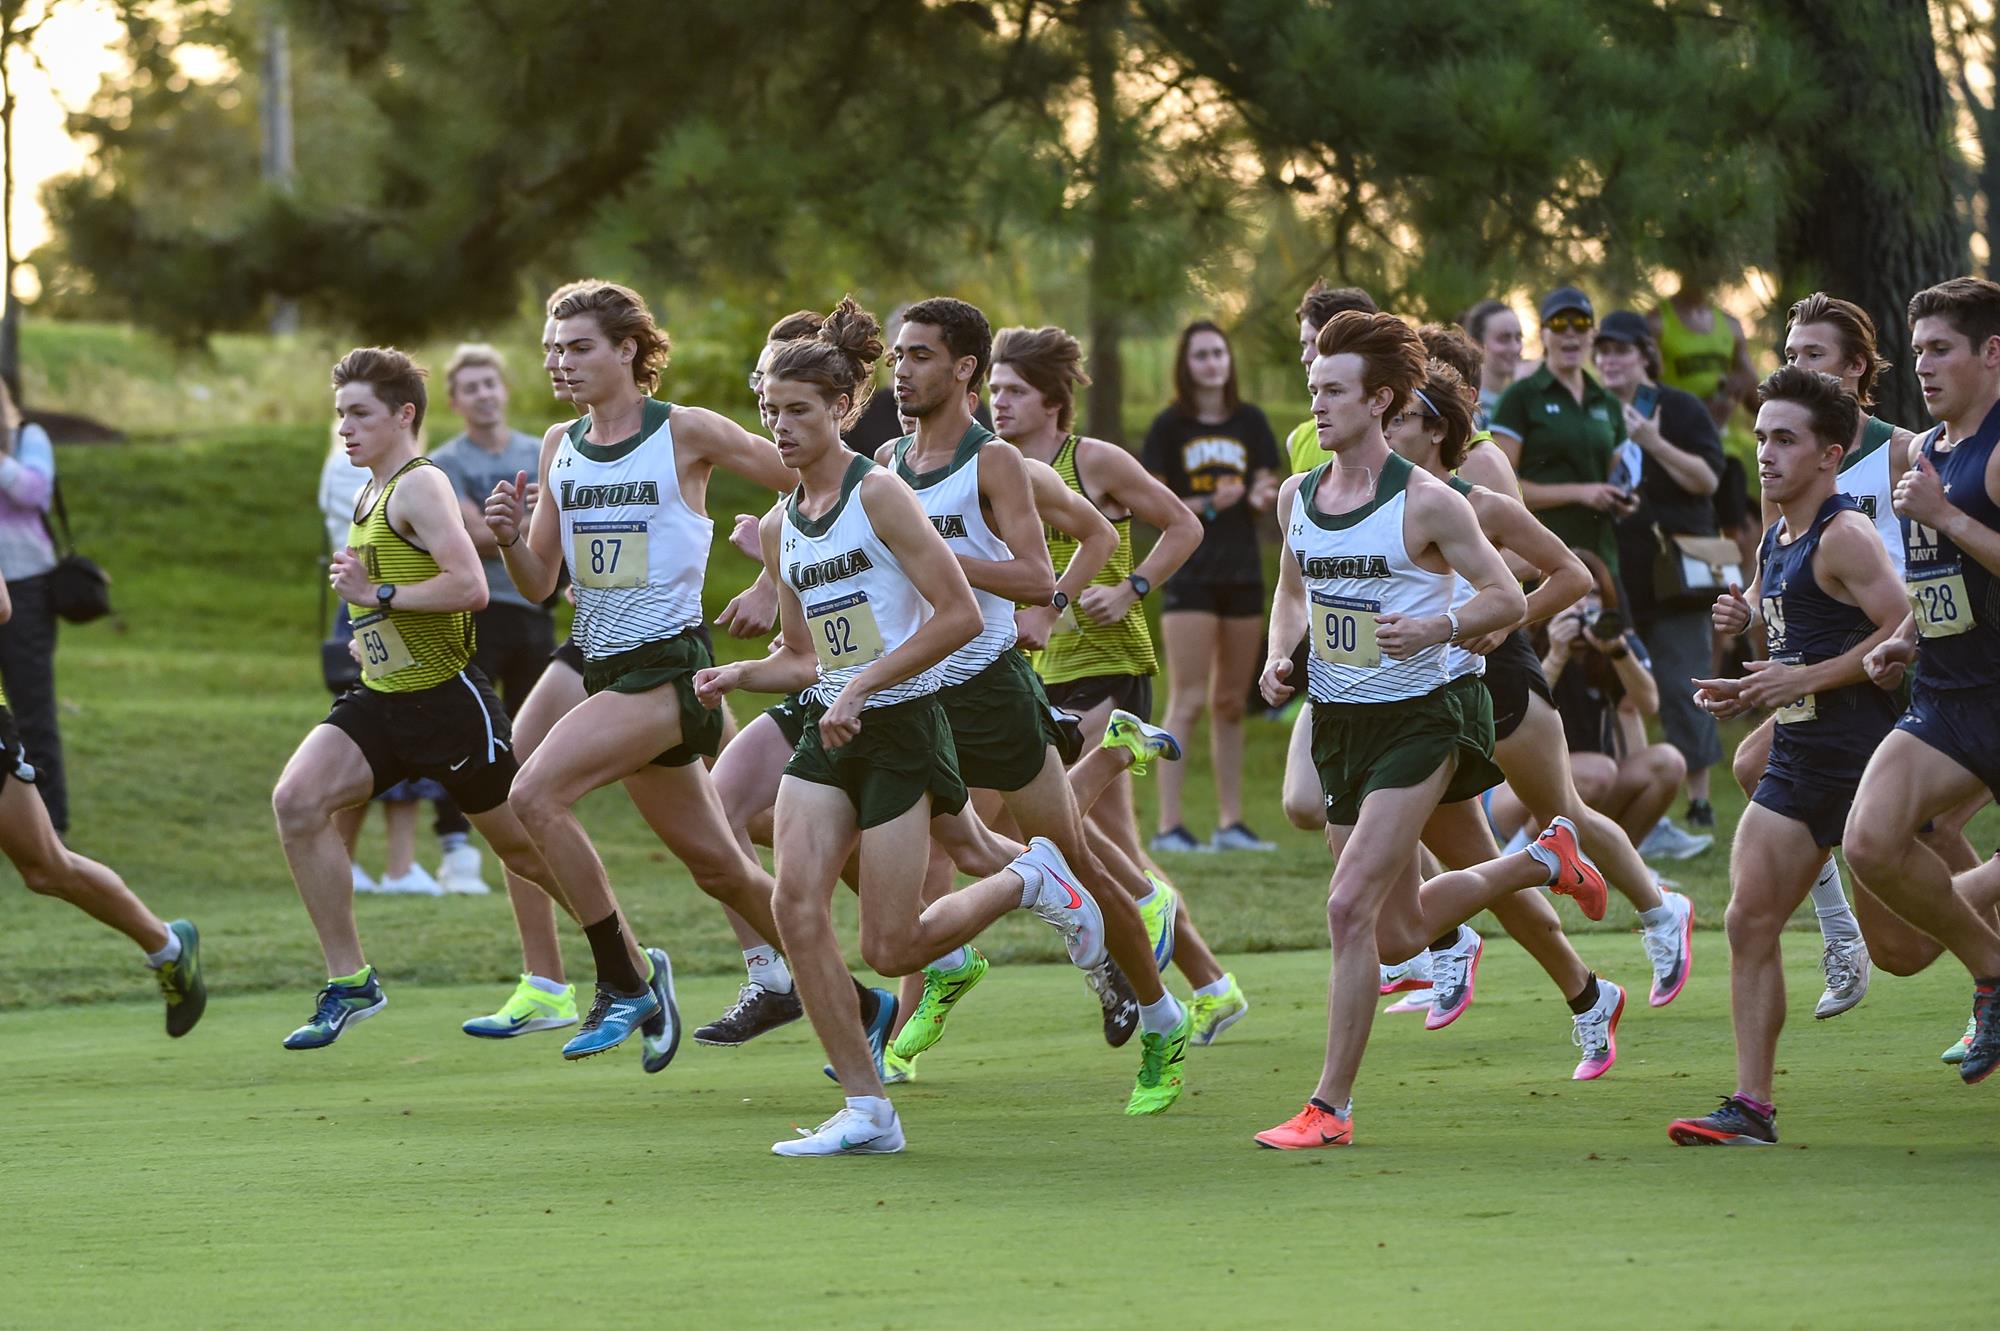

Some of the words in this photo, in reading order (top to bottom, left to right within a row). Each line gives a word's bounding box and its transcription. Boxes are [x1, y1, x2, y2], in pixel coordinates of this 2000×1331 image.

[561, 480, 659, 511] LOYOLA
[591, 539, 622, 574] 87
[789, 548, 873, 592] LOYOLA
[1910, 548, 1938, 561] NAVY
[1915, 584, 1957, 623] 128
[363, 630, 389, 665] 59
[824, 617, 858, 656] 92
[1325, 613, 1356, 652] 90
